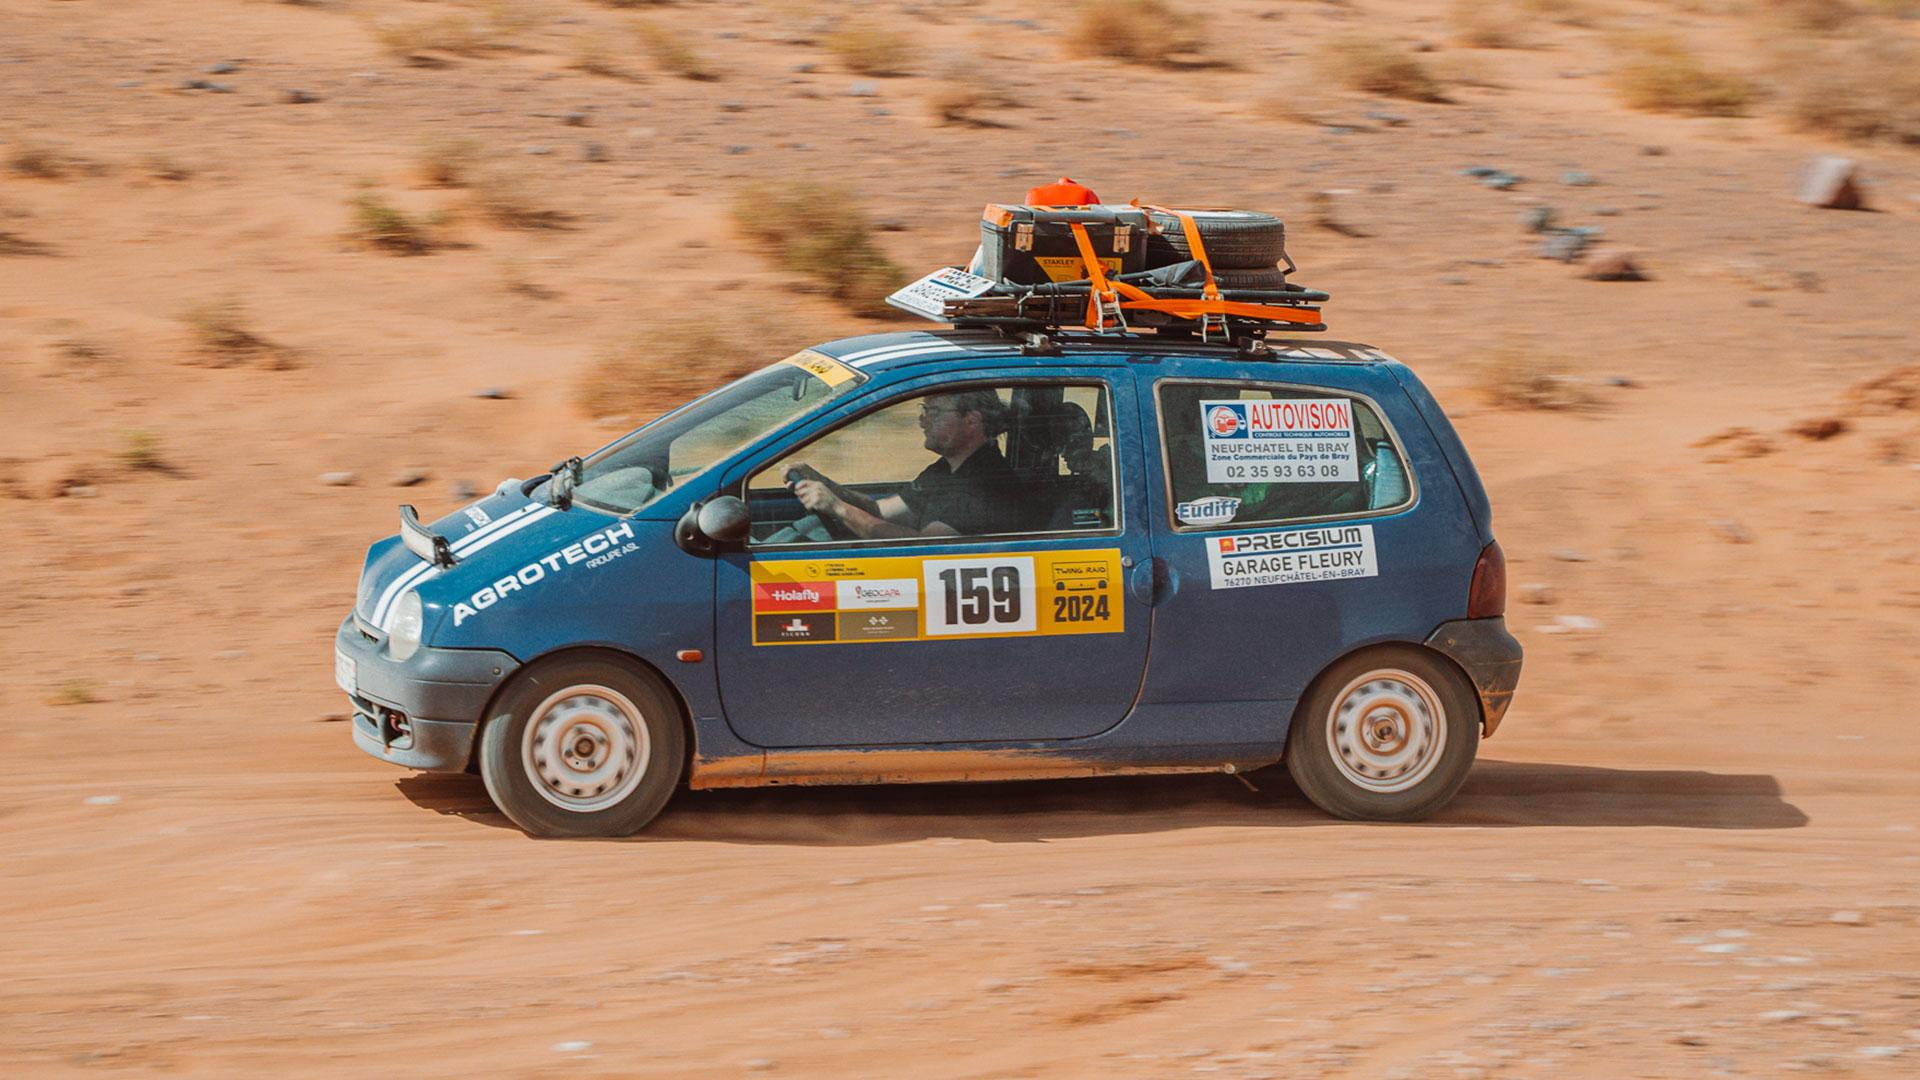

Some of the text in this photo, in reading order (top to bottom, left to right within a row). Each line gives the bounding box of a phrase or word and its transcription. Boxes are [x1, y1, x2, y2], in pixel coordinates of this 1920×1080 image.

[1252, 403, 1349, 429] AUTOVISION
[1211, 443, 1349, 454] NEUFCHATEL EN BRAY
[1332, 453, 1350, 461] Bray
[1227, 465, 1339, 478] 02 35 93 63 08
[1178, 501, 1238, 519] Eudiff
[1236, 528, 1362, 552] PRECISIUM
[585, 548, 623, 569] GROUPE
[1223, 551, 1363, 576] GARAGE FLEURY
[452, 522, 635, 627] AGROTECH
[1224, 578, 1251, 587] 76270
[771, 589, 820, 603] Holafly
[939, 566, 1021, 625] 159
[1054, 595, 1110, 622] 2024
